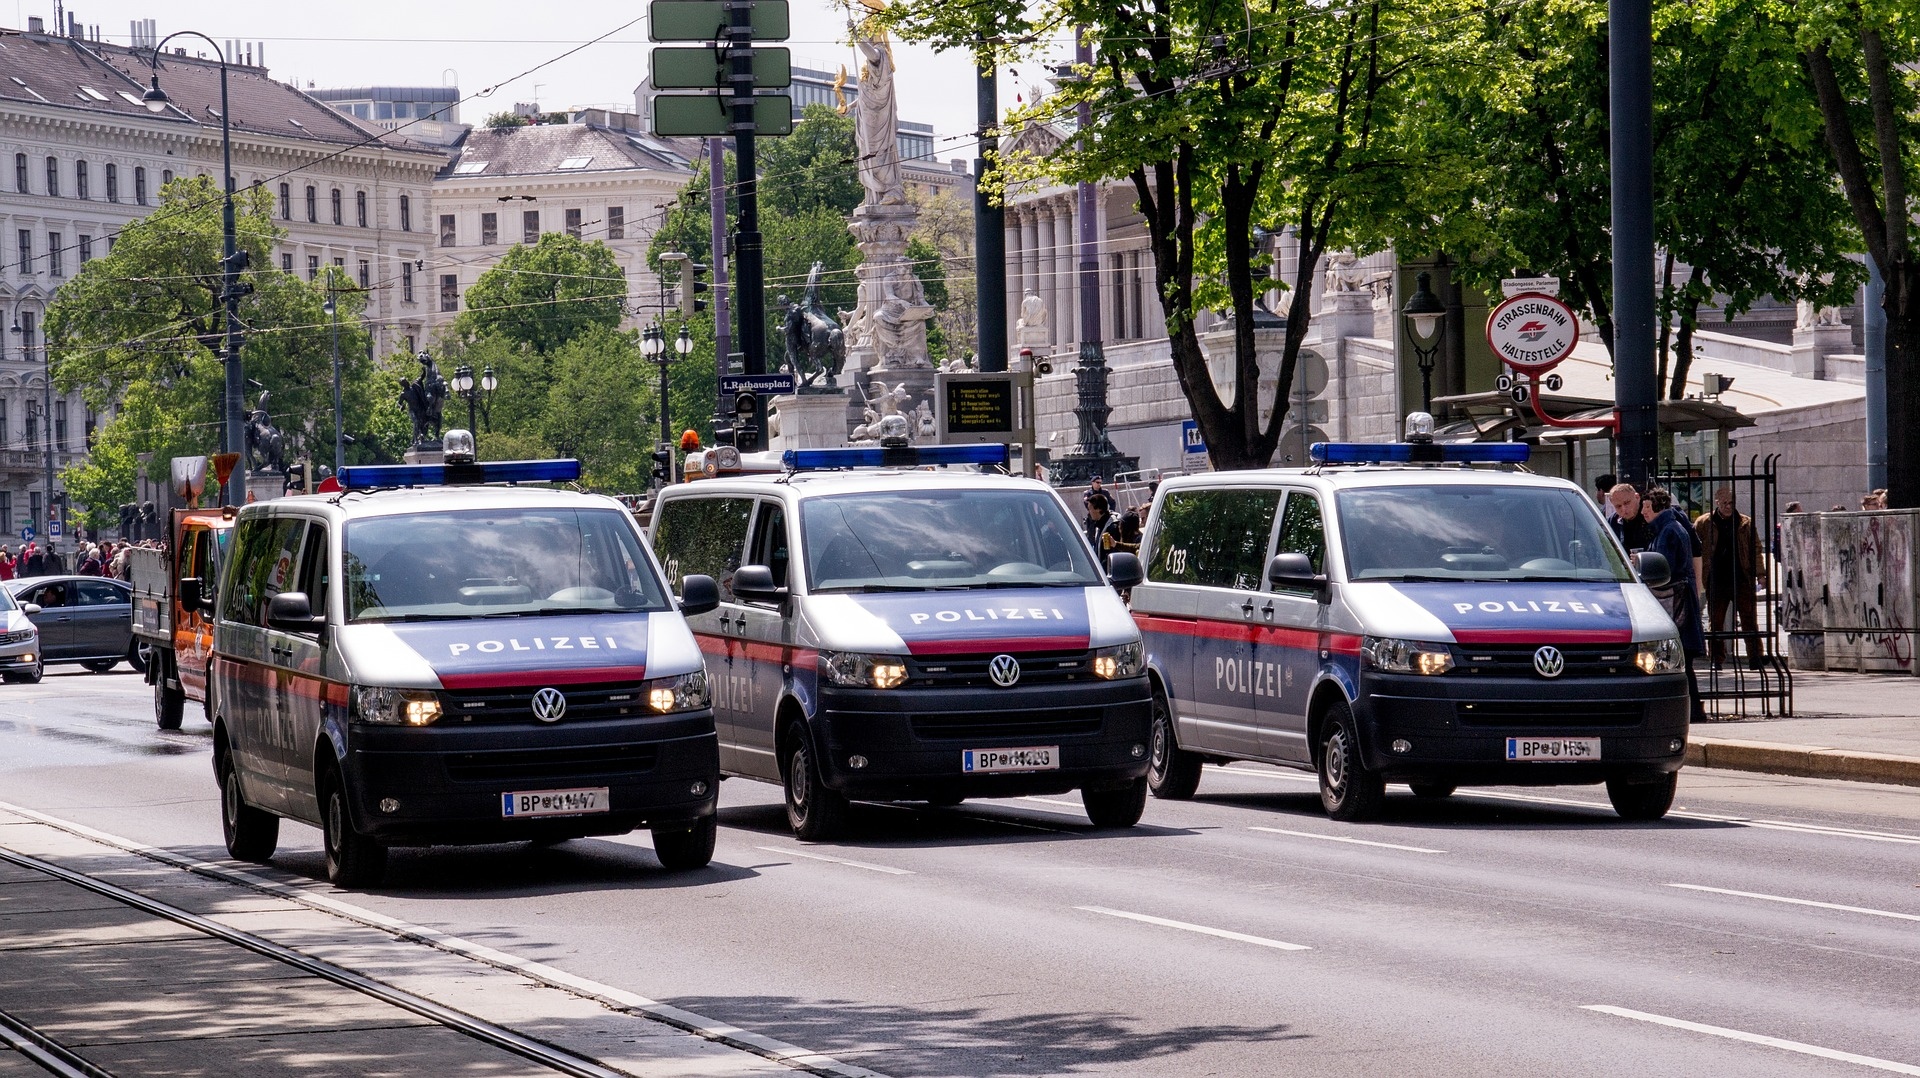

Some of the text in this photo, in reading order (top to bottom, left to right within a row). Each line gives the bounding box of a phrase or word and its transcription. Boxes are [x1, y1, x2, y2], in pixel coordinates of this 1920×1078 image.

[1497, 303, 1567, 330] STRASSENBAHN
[1501, 338, 1566, 361] HALTESTELLE
[731, 380, 791, 390] Rathausplatz
[1499, 378, 1510, 390] D
[1548, 377, 1561, 388] 71
[1515, 388, 1523, 401] 1
[1173, 549, 1187, 575] 133
[668, 559, 679, 585] 133
[910, 608, 1064, 625] POLIZEI
[1453, 601, 1605, 615] POLIZEI
[449, 636, 618, 656] POLIZEI
[1216, 656, 1282, 698] POLIZEI
[709, 672, 754, 713] OLIZEI
[257, 706, 299, 751] POLIZEI
[1523, 742, 1540, 756] BP
[980, 753, 998, 768] BP
[521, 796, 540, 811] BP
